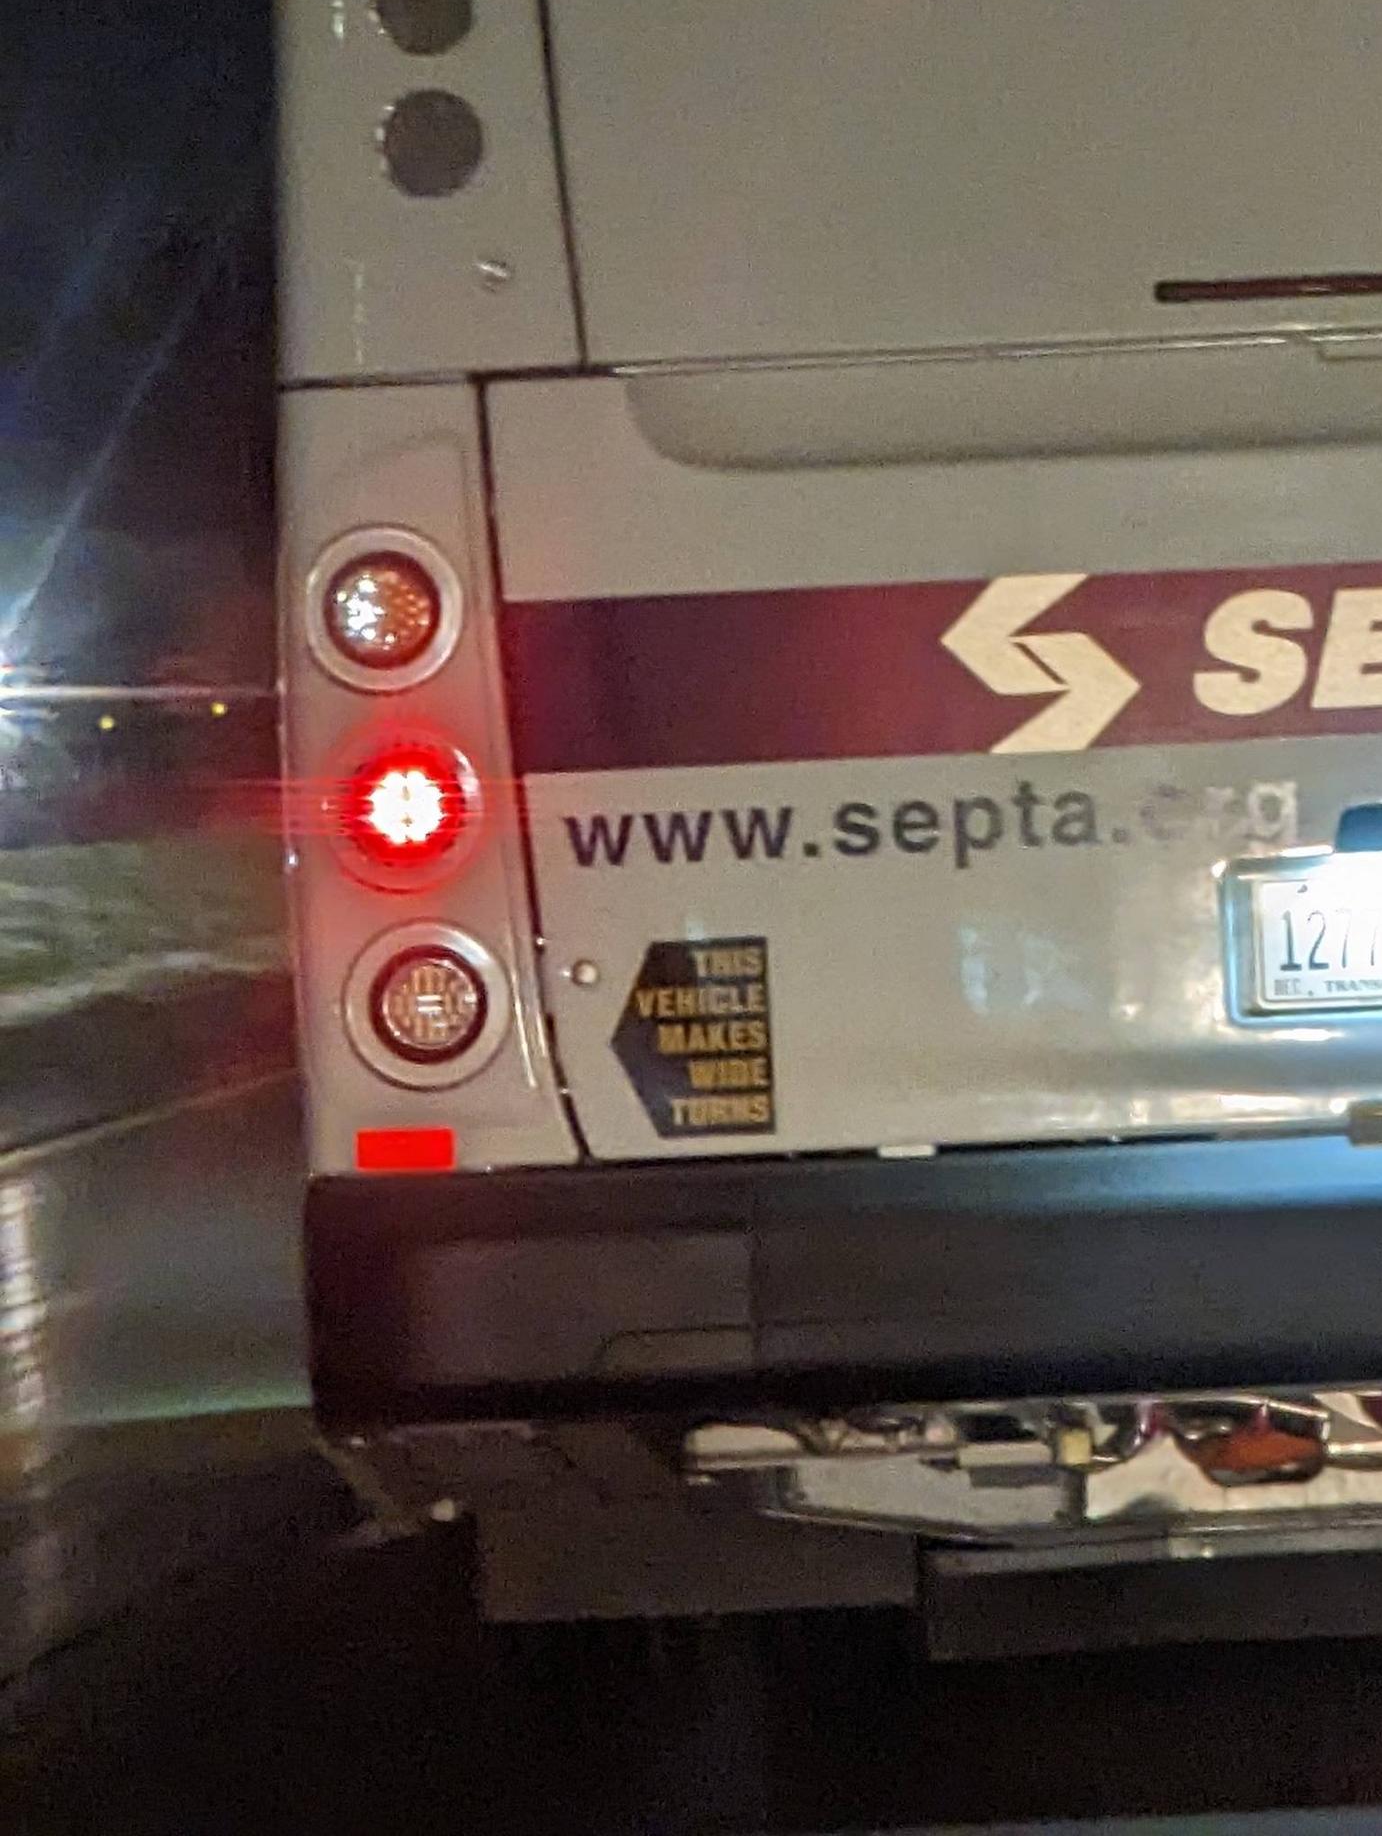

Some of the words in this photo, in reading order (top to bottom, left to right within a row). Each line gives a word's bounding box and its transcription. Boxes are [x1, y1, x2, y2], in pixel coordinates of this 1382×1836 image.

[695, 947, 765, 978] THIS
[634, 983, 768, 1018] VEHICLE
[657, 1020, 770, 1054] MAKES
[688, 1057, 771, 1090] WIDE
